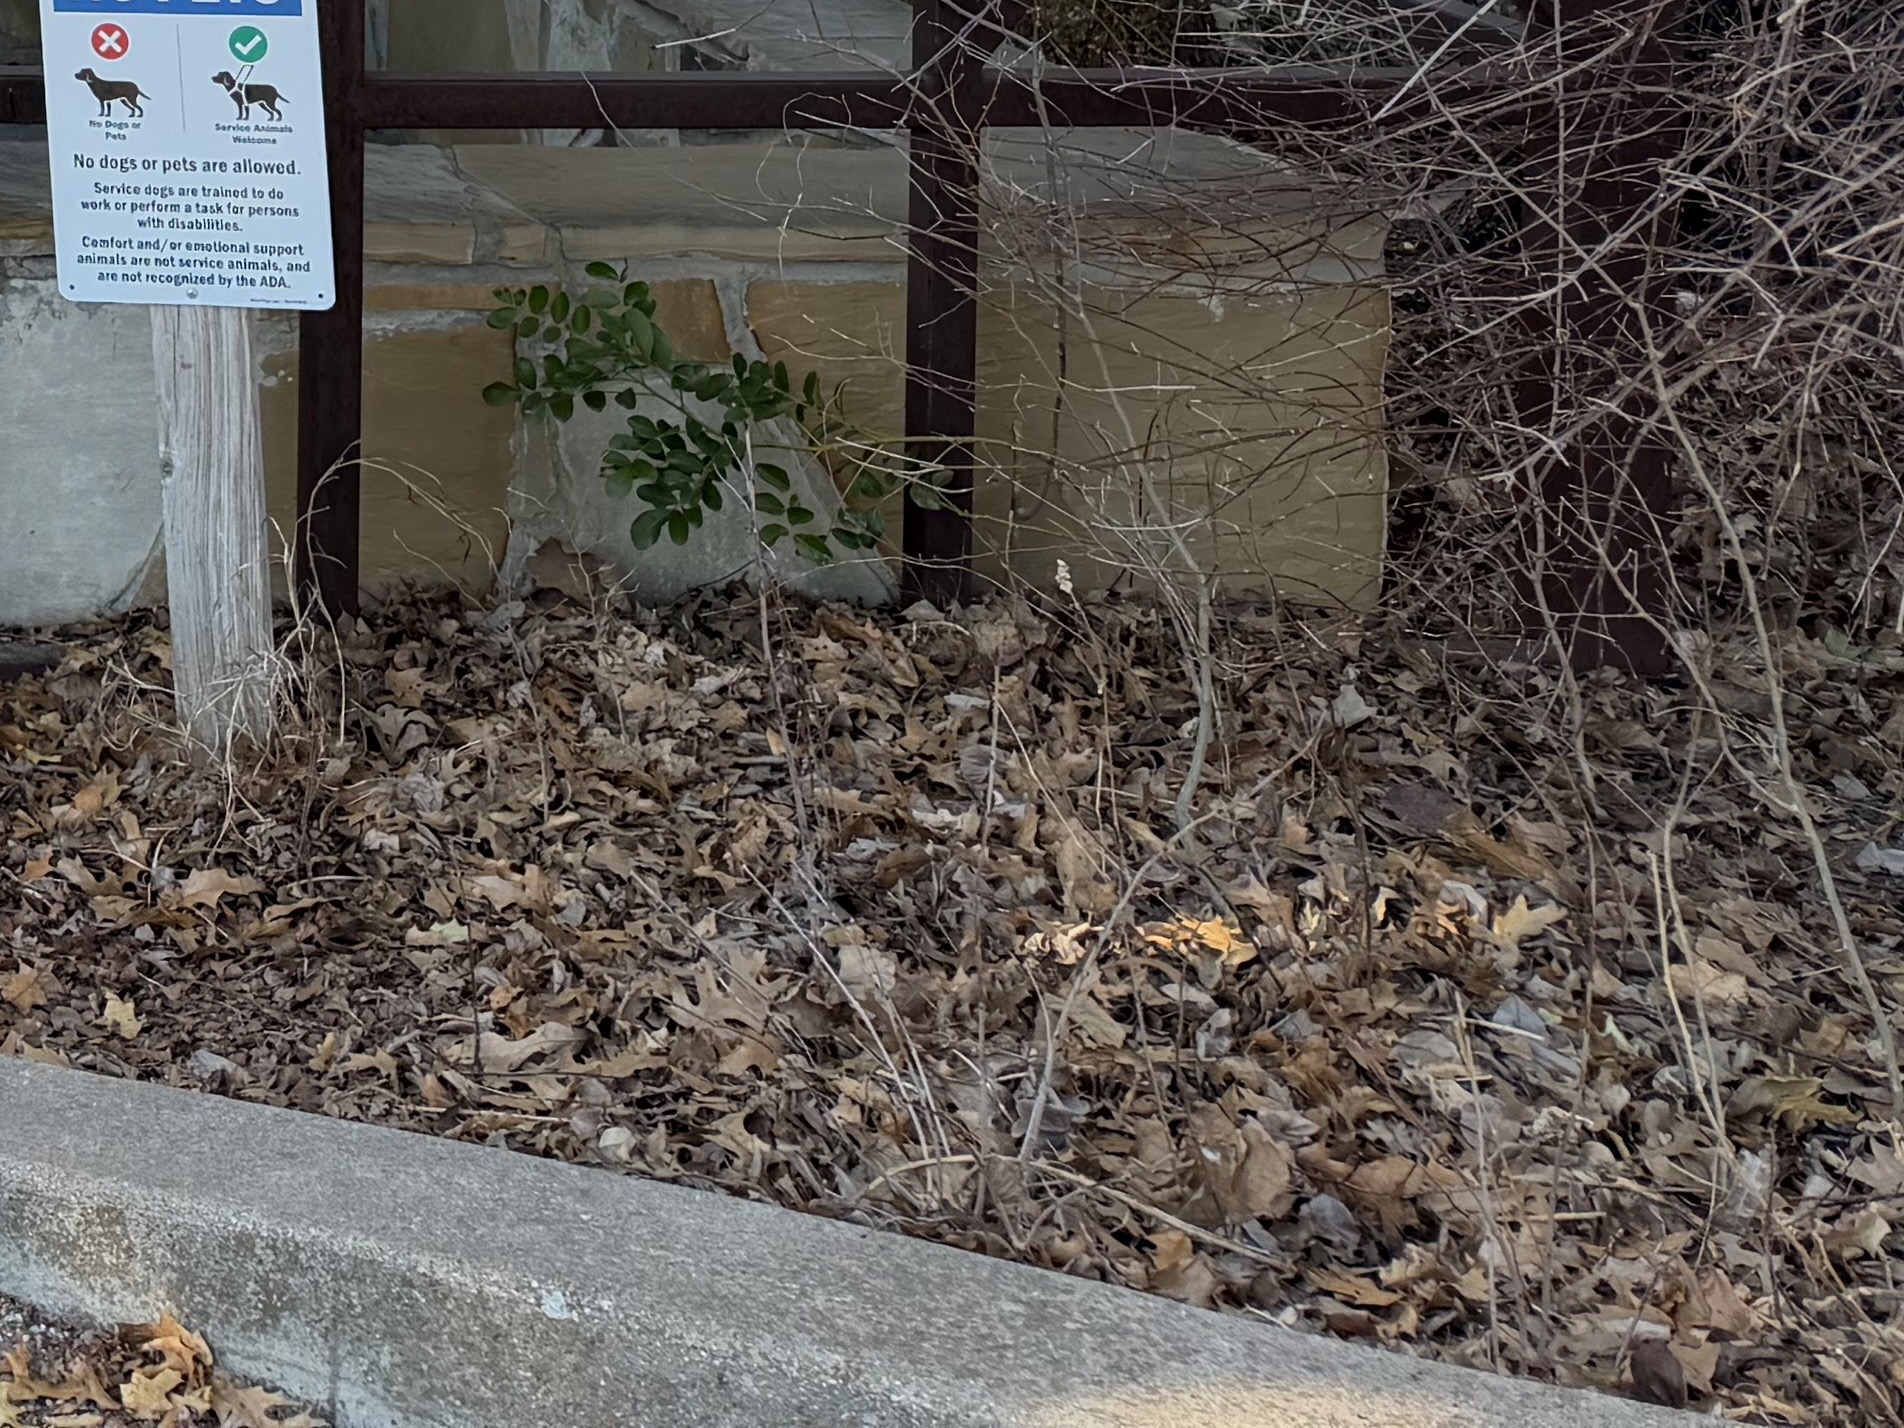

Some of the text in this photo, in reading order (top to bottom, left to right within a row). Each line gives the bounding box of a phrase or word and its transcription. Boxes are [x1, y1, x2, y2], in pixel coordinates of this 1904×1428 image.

[74, 154, 301, 175] No dogs or pets are allowed.
[94, 182, 283, 200] Service dogs are trained to do
[81, 199, 299, 217] work or perform a task for persons
[137, 217, 242, 231] with disabilities.
[82, 236, 304, 256] Comfort and/or emotional support
[77, 253, 310, 272] animals are not service animals, and
[97, 271, 291, 288] are not recognized by the ADA.
